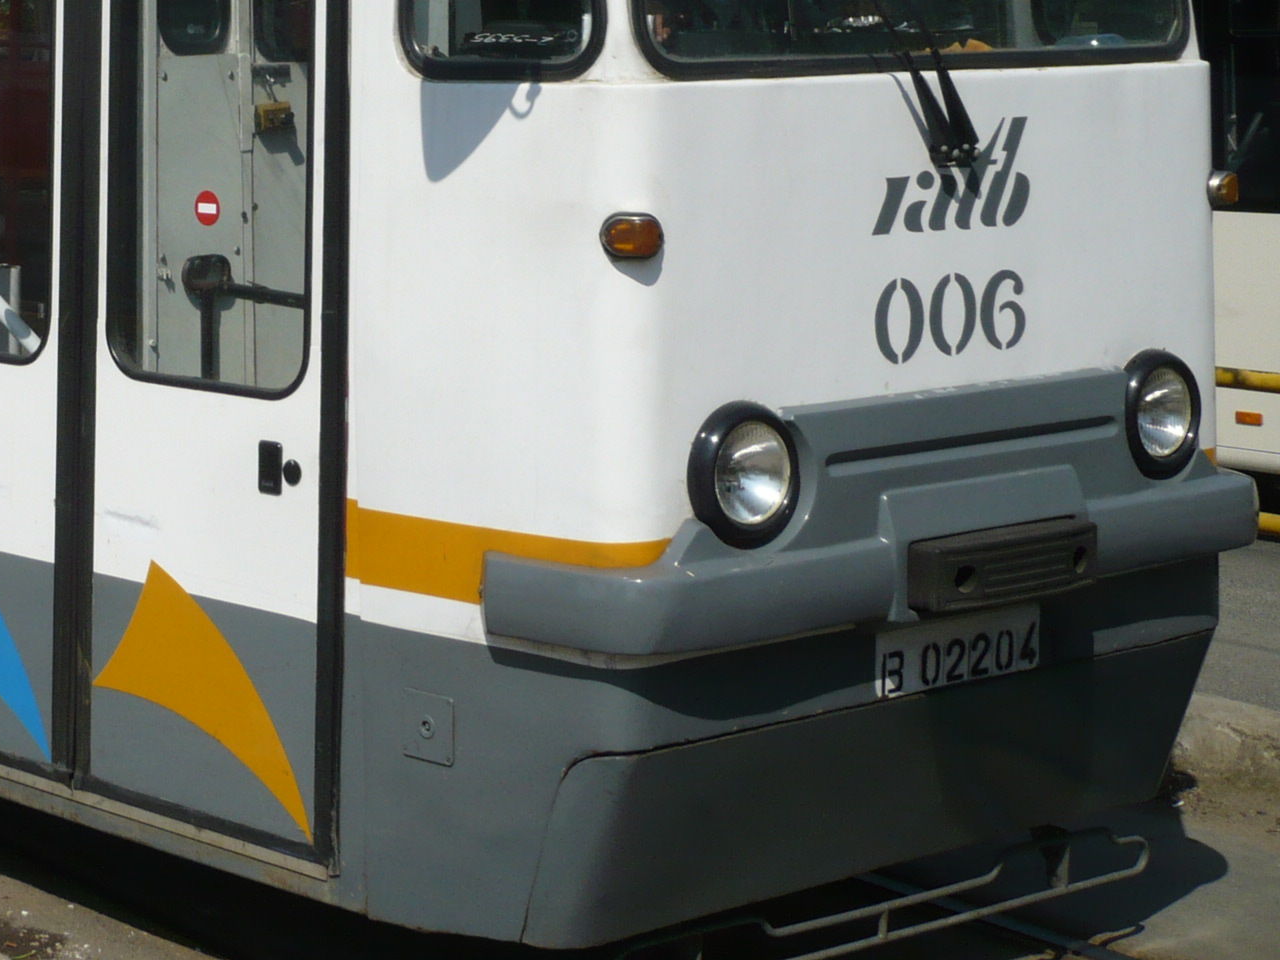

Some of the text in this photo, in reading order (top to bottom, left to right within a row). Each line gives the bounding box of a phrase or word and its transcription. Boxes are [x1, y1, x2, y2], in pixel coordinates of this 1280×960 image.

[874, 268, 1027, 365] 006
[881, 620, 1038, 697] B 02204
